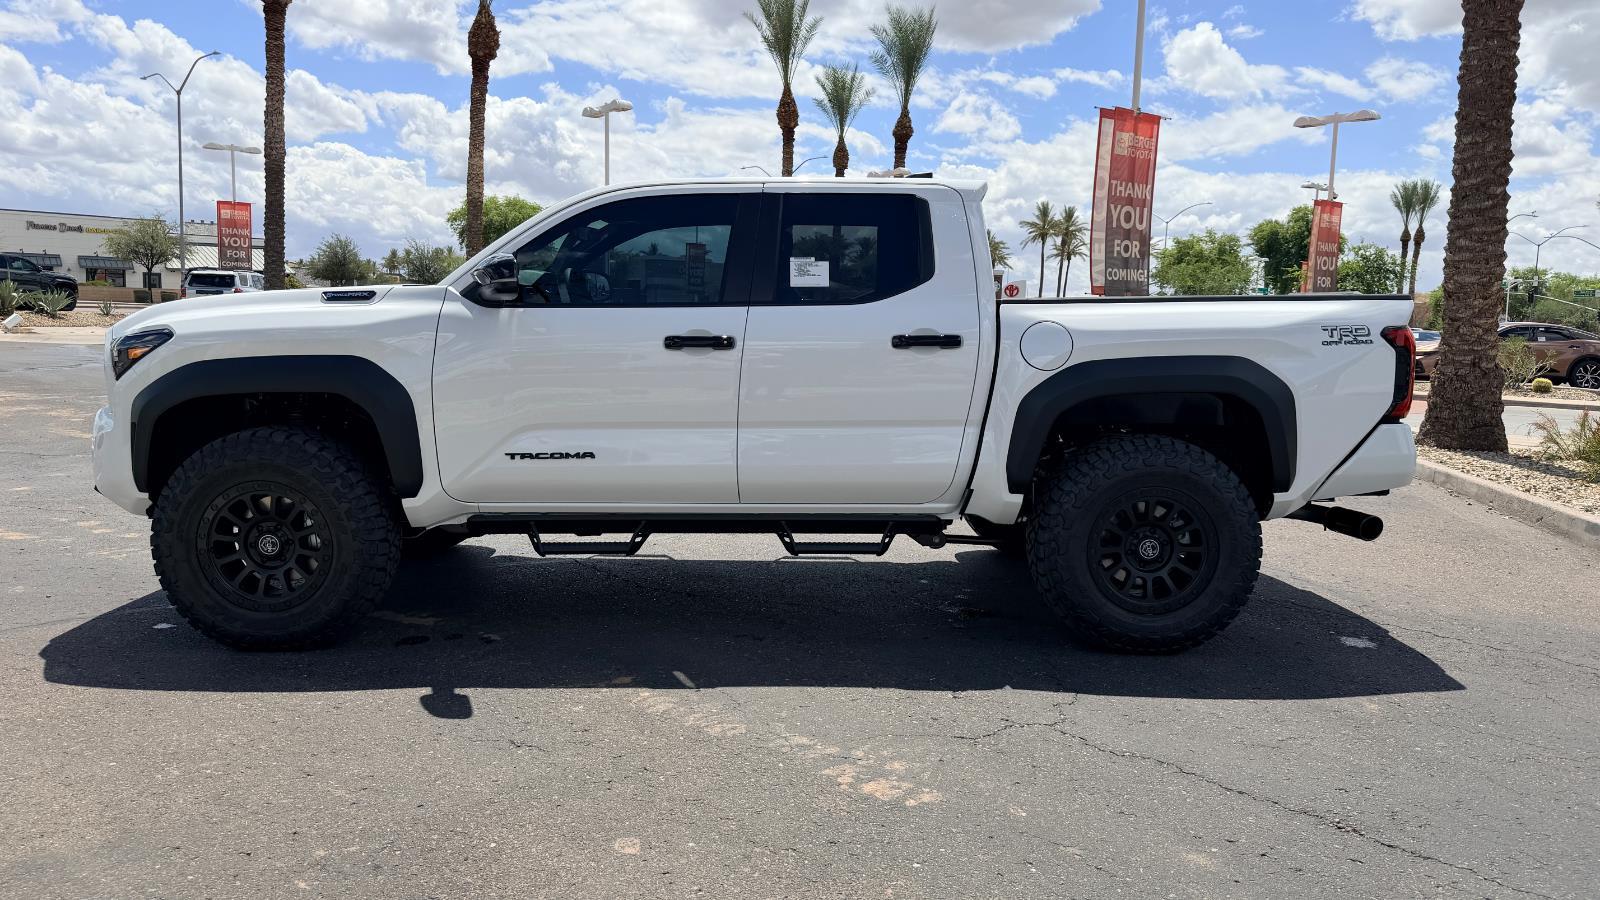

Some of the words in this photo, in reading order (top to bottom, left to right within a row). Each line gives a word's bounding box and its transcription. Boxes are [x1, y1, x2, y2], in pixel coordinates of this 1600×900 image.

[1127, 147, 1153, 160] TOYOTA
[1111, 180, 1151, 200] THANK
[1110, 204, 1148, 230] YOU
[221, 227, 250, 236] THANK
[222, 237, 249, 248] YOU
[1113, 239, 1141, 259] FOR
[1317, 241, 1338, 253] THANK
[227, 250, 246, 259] FOR
[1316, 255, 1336, 271] YOU
[1106, 268, 1148, 282] COMING!
[1317, 276, 1332, 288] FOR
[1321, 324, 1371, 340] TRD
[504, 451, 596, 460] TACOMA
